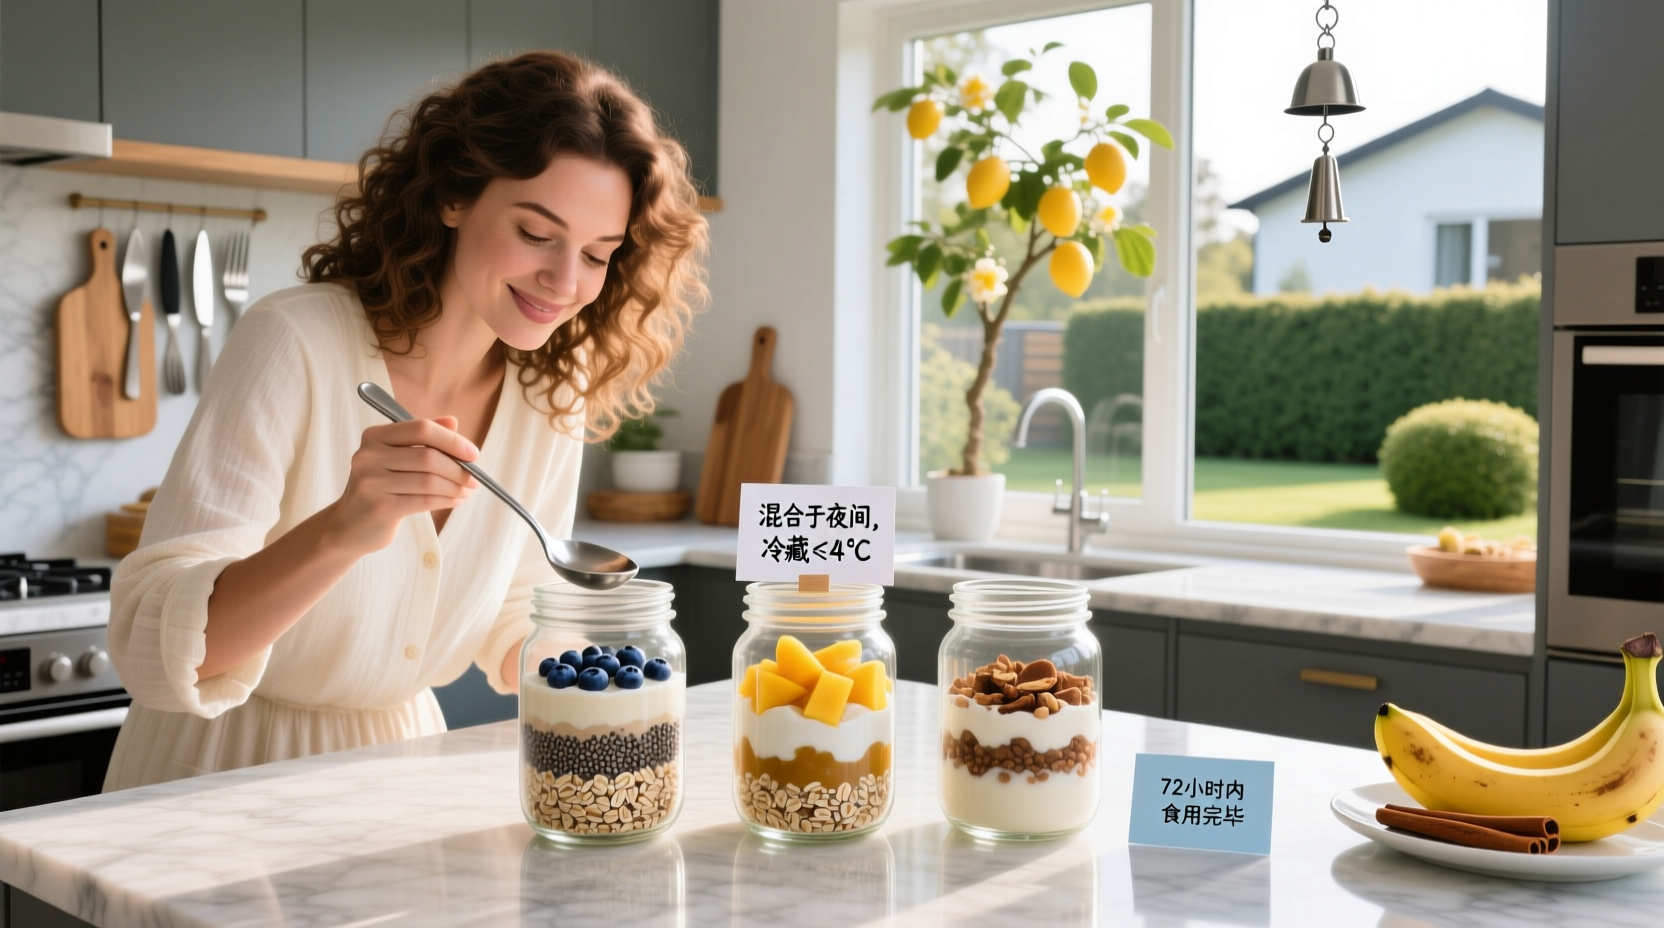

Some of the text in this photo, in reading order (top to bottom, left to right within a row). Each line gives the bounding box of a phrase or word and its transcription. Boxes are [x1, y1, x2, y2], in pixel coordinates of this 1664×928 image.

[1161, 777, 1244, 801] 72小时内
[1161, 802, 1245, 828] 食用完毕
